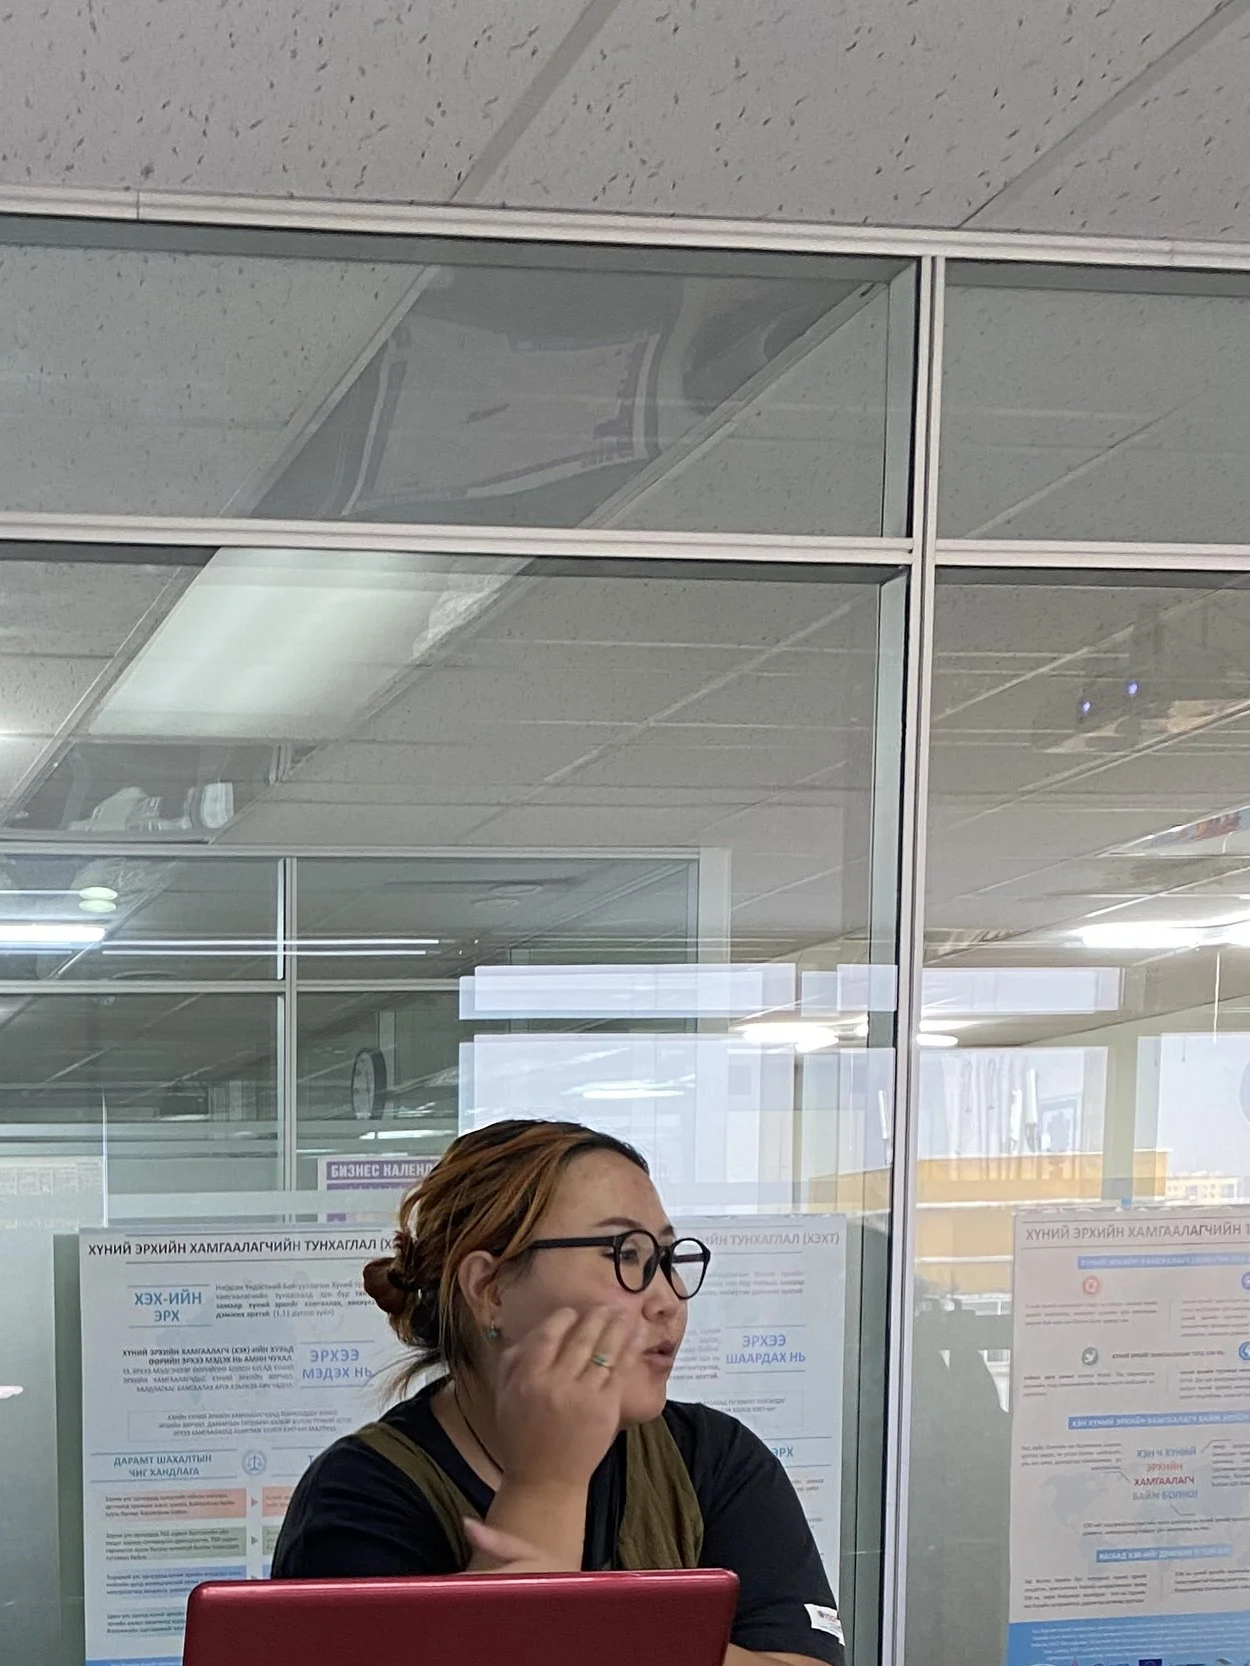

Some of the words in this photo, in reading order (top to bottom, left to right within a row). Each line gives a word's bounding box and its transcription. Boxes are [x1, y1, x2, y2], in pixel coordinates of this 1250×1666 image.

[331, 1164, 380, 1178] БИЗНЕС
[730, 1232, 800, 1246] ТУНХАГЛАЛ
[802, 1231, 840, 1246] (ХЭХТ)
[1026, 1224, 1070, 1241] ХҮНИЙ
[1072, 1223, 1125, 1240] ЭРХИЙН
[1128, 1222, 1241, 1239] ХАМГААЛАГЧИЙН
[88, 1240, 132, 1256] ХҮНИЙ
[135, 1239, 187, 1255] ЭРХИЙН
[190, 1237, 301, 1254] ХАМГААЛАГЧИЙН
[304, 1238, 377, 1252] ТУНХАГЛАЛ
[134, 1288, 202, 1306] ХЭХ-ИЙН
[154, 1309, 180, 1322] ЭРХ
[742, 1334, 786, 1348] ЭРХЭЭ
[310, 1348, 360, 1363] ЭРХЭЭ
[726, 1351, 787, 1366] ШААРДАХ
[789, 1351, 806, 1363] НЬ
[302, 1366, 350, 1380] МЭДЭХ
[354, 1366, 373, 1378] НЬ
[114, 1454, 153, 1467] ДАРАМТ
[156, 1454, 212, 1465] ШАХАЛТЫН
[128, 1467, 147, 1477] ЧИГ
[150, 1467, 200, 1478] ХАНДЛАГА
[1134, 1476, 1195, 1486] ХАМГААЛАГЧ
